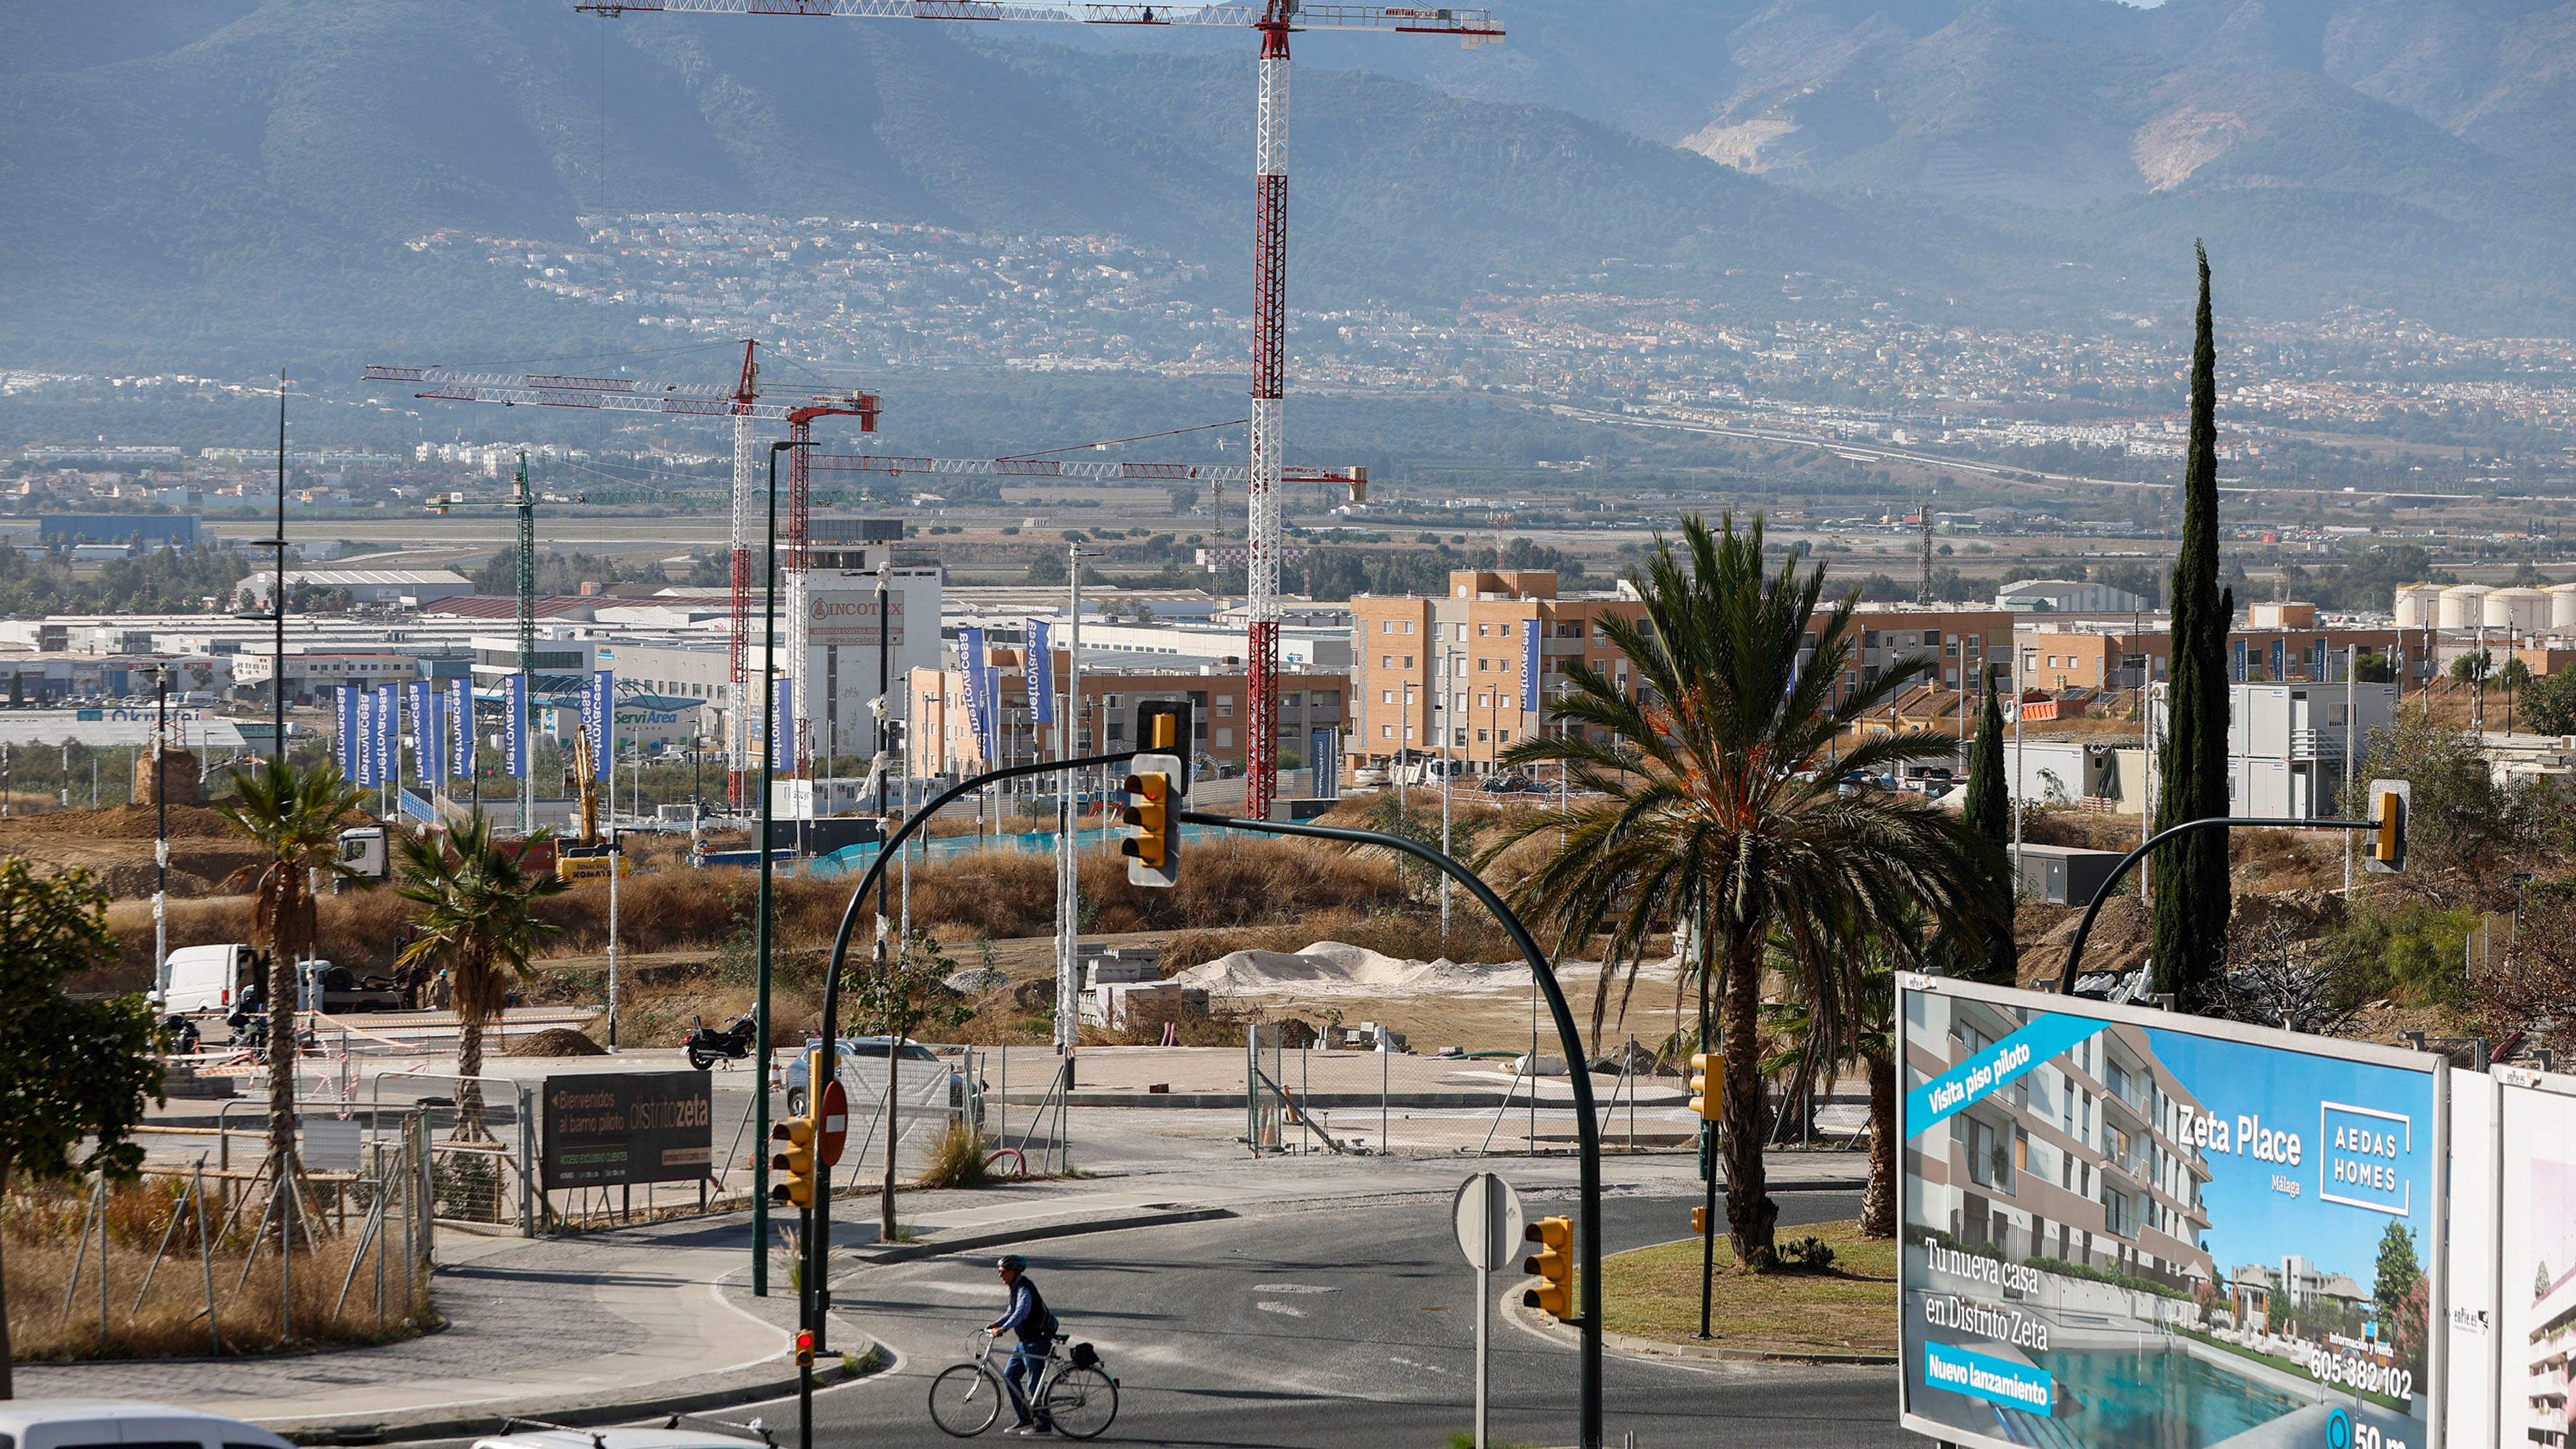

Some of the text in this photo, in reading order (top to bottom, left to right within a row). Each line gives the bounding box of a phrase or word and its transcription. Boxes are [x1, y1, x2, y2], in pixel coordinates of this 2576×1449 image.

[1386, 9, 1437, 17] metalgrua
[614, 710, 678, 724] ServiArea
[1928, 1043, 2031, 1115] Visita piso piloto
[559, 1089, 615, 1109] Bienvenidos
[630, 1093, 709, 1129] distritozeta
[559, 1112, 625, 1136] al barrio piloto
[2179, 1104, 2302, 1166] Zeta Place
[2335, 1125, 2396, 1159] AEDAS
[2271, 1174, 2301, 1198] Málaga
[2335, 1158, 2396, 1192] HOMES
[1925, 1237, 2039, 1294] Tu nueva casa
[1926, 1296, 2049, 1351] en Distrito Zeta
[2329, 1331, 2394, 1358] Información y venta
[1929, 1354, 2047, 1407] Nuevo lanzamiento
[2311, 1349, 2412, 1401] 605 382 102
[2355, 1423, 2380, 1449] 50
